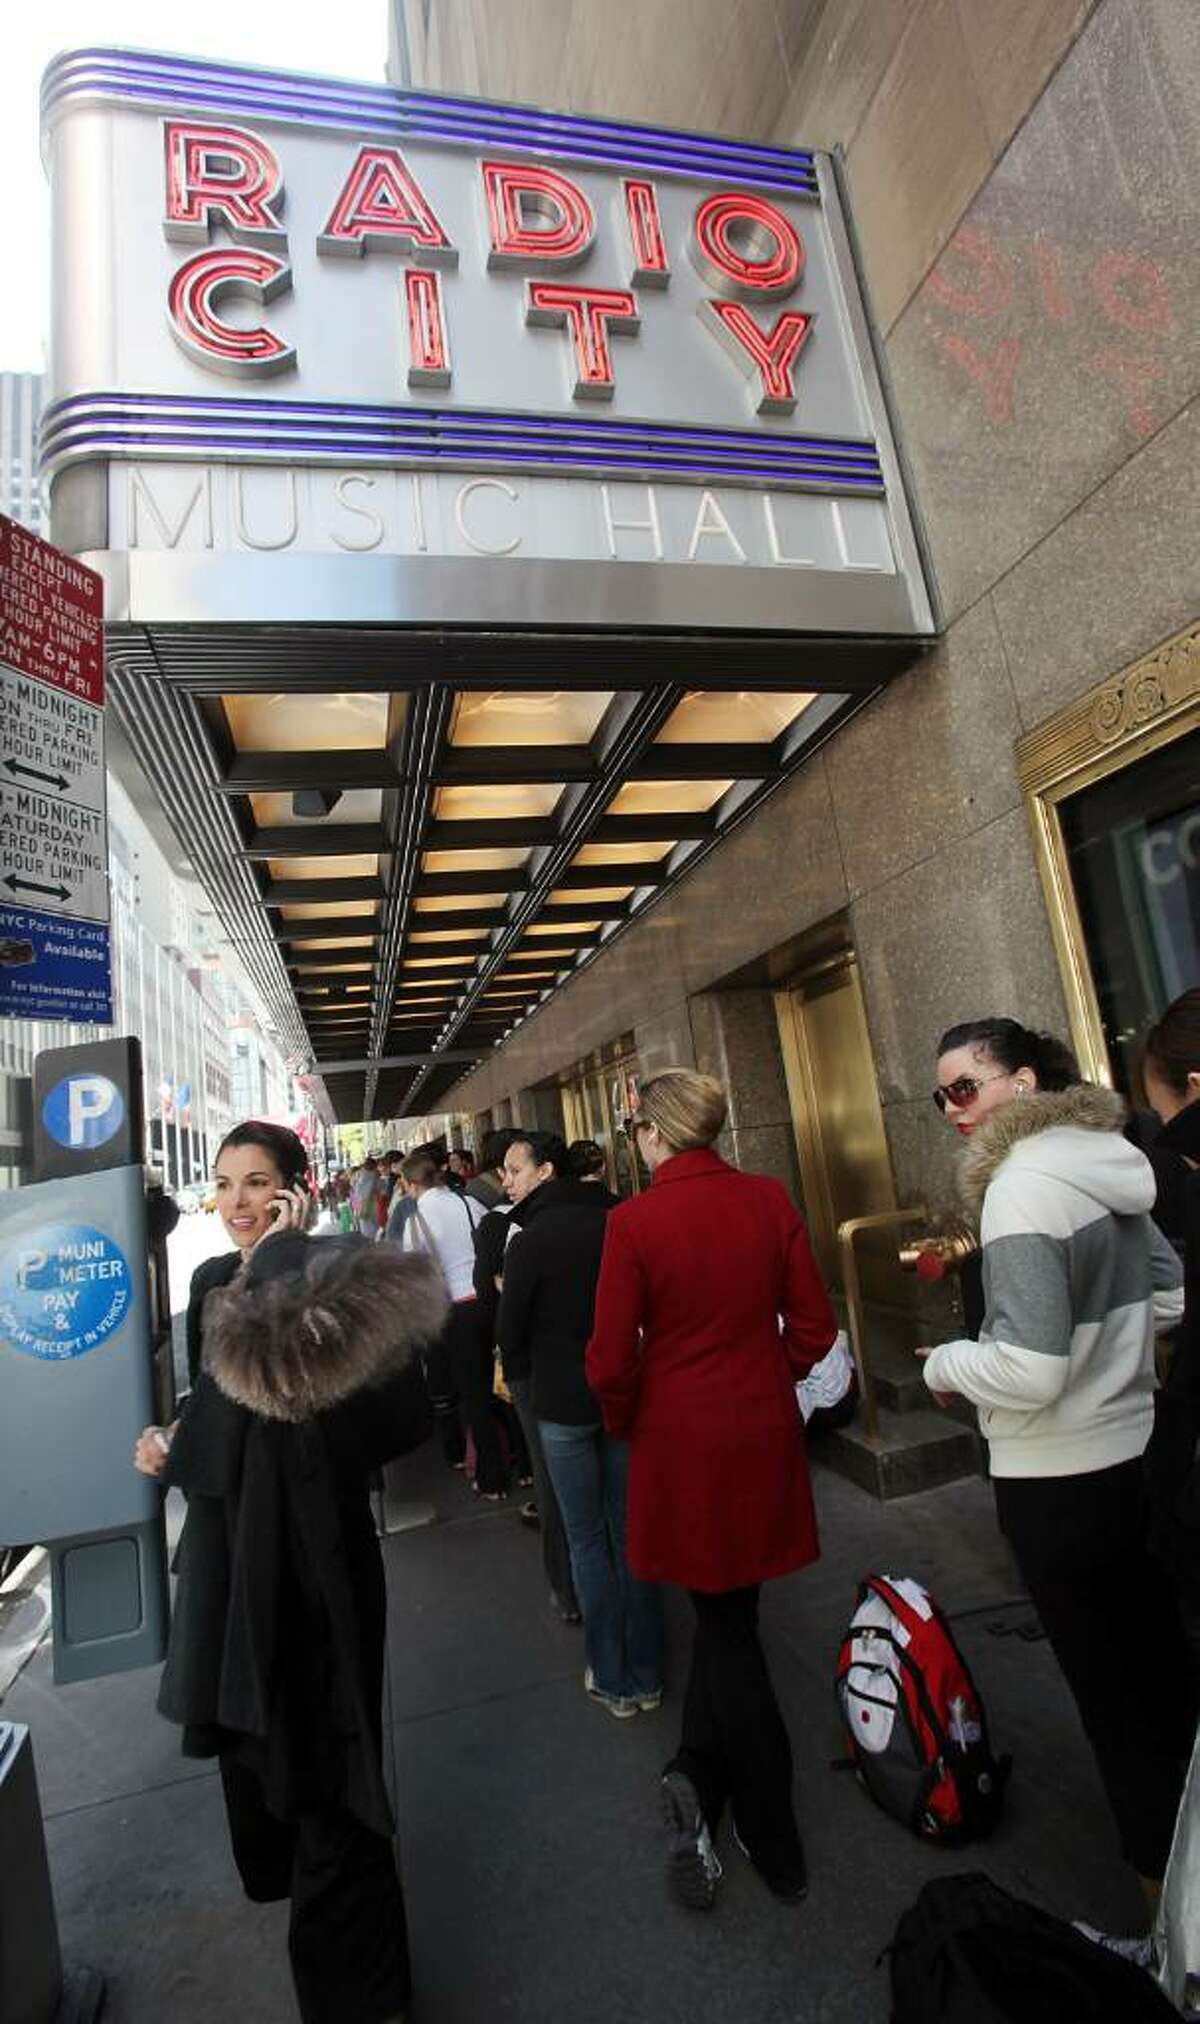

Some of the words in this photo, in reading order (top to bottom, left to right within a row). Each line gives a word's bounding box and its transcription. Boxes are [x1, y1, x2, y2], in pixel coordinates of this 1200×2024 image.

[161, 117, 806, 294] RADIO
[167, 246, 816, 412] CITY
[128, 466, 523, 556] MUSIC
[600, 484, 884, 572] HALL
[10, 532, 94, 597] STANDING
[12, 555, 63, 594] EXCEPT
[4, 602, 43, 635] HOUR
[49, 625, 81, 654] LIMIT
[43, 605, 97, 646] PARKING
[50, 592, 99, 631] VEHICLES
[26, 656, 60, 681] THRU
[64, 671, 91, 696] FRI
[43, 732, 98, 766] PARKING
[65, 723, 92, 745] FRI
[3, 734, 42, 763] HOUR
[48, 750, 82, 776] LIMIT
[3, 850, 44, 875] HOUR
[50, 862, 84, 884] LIMIT
[43, 840, 102, 871] PARKING
[28, 917, 75, 940] Parking
[77, 928, 105, 943] Card
[44, 940, 105, 961] Available
[69, 1079, 114, 1145] P
[58, 1240, 105, 1262] MUNI
[58, 1259, 123, 1286] METER
[43, 1290, 80, 1312] PAY
[53, 1312, 71, 1330] &
[84, 1330, 98, 1344] IN
